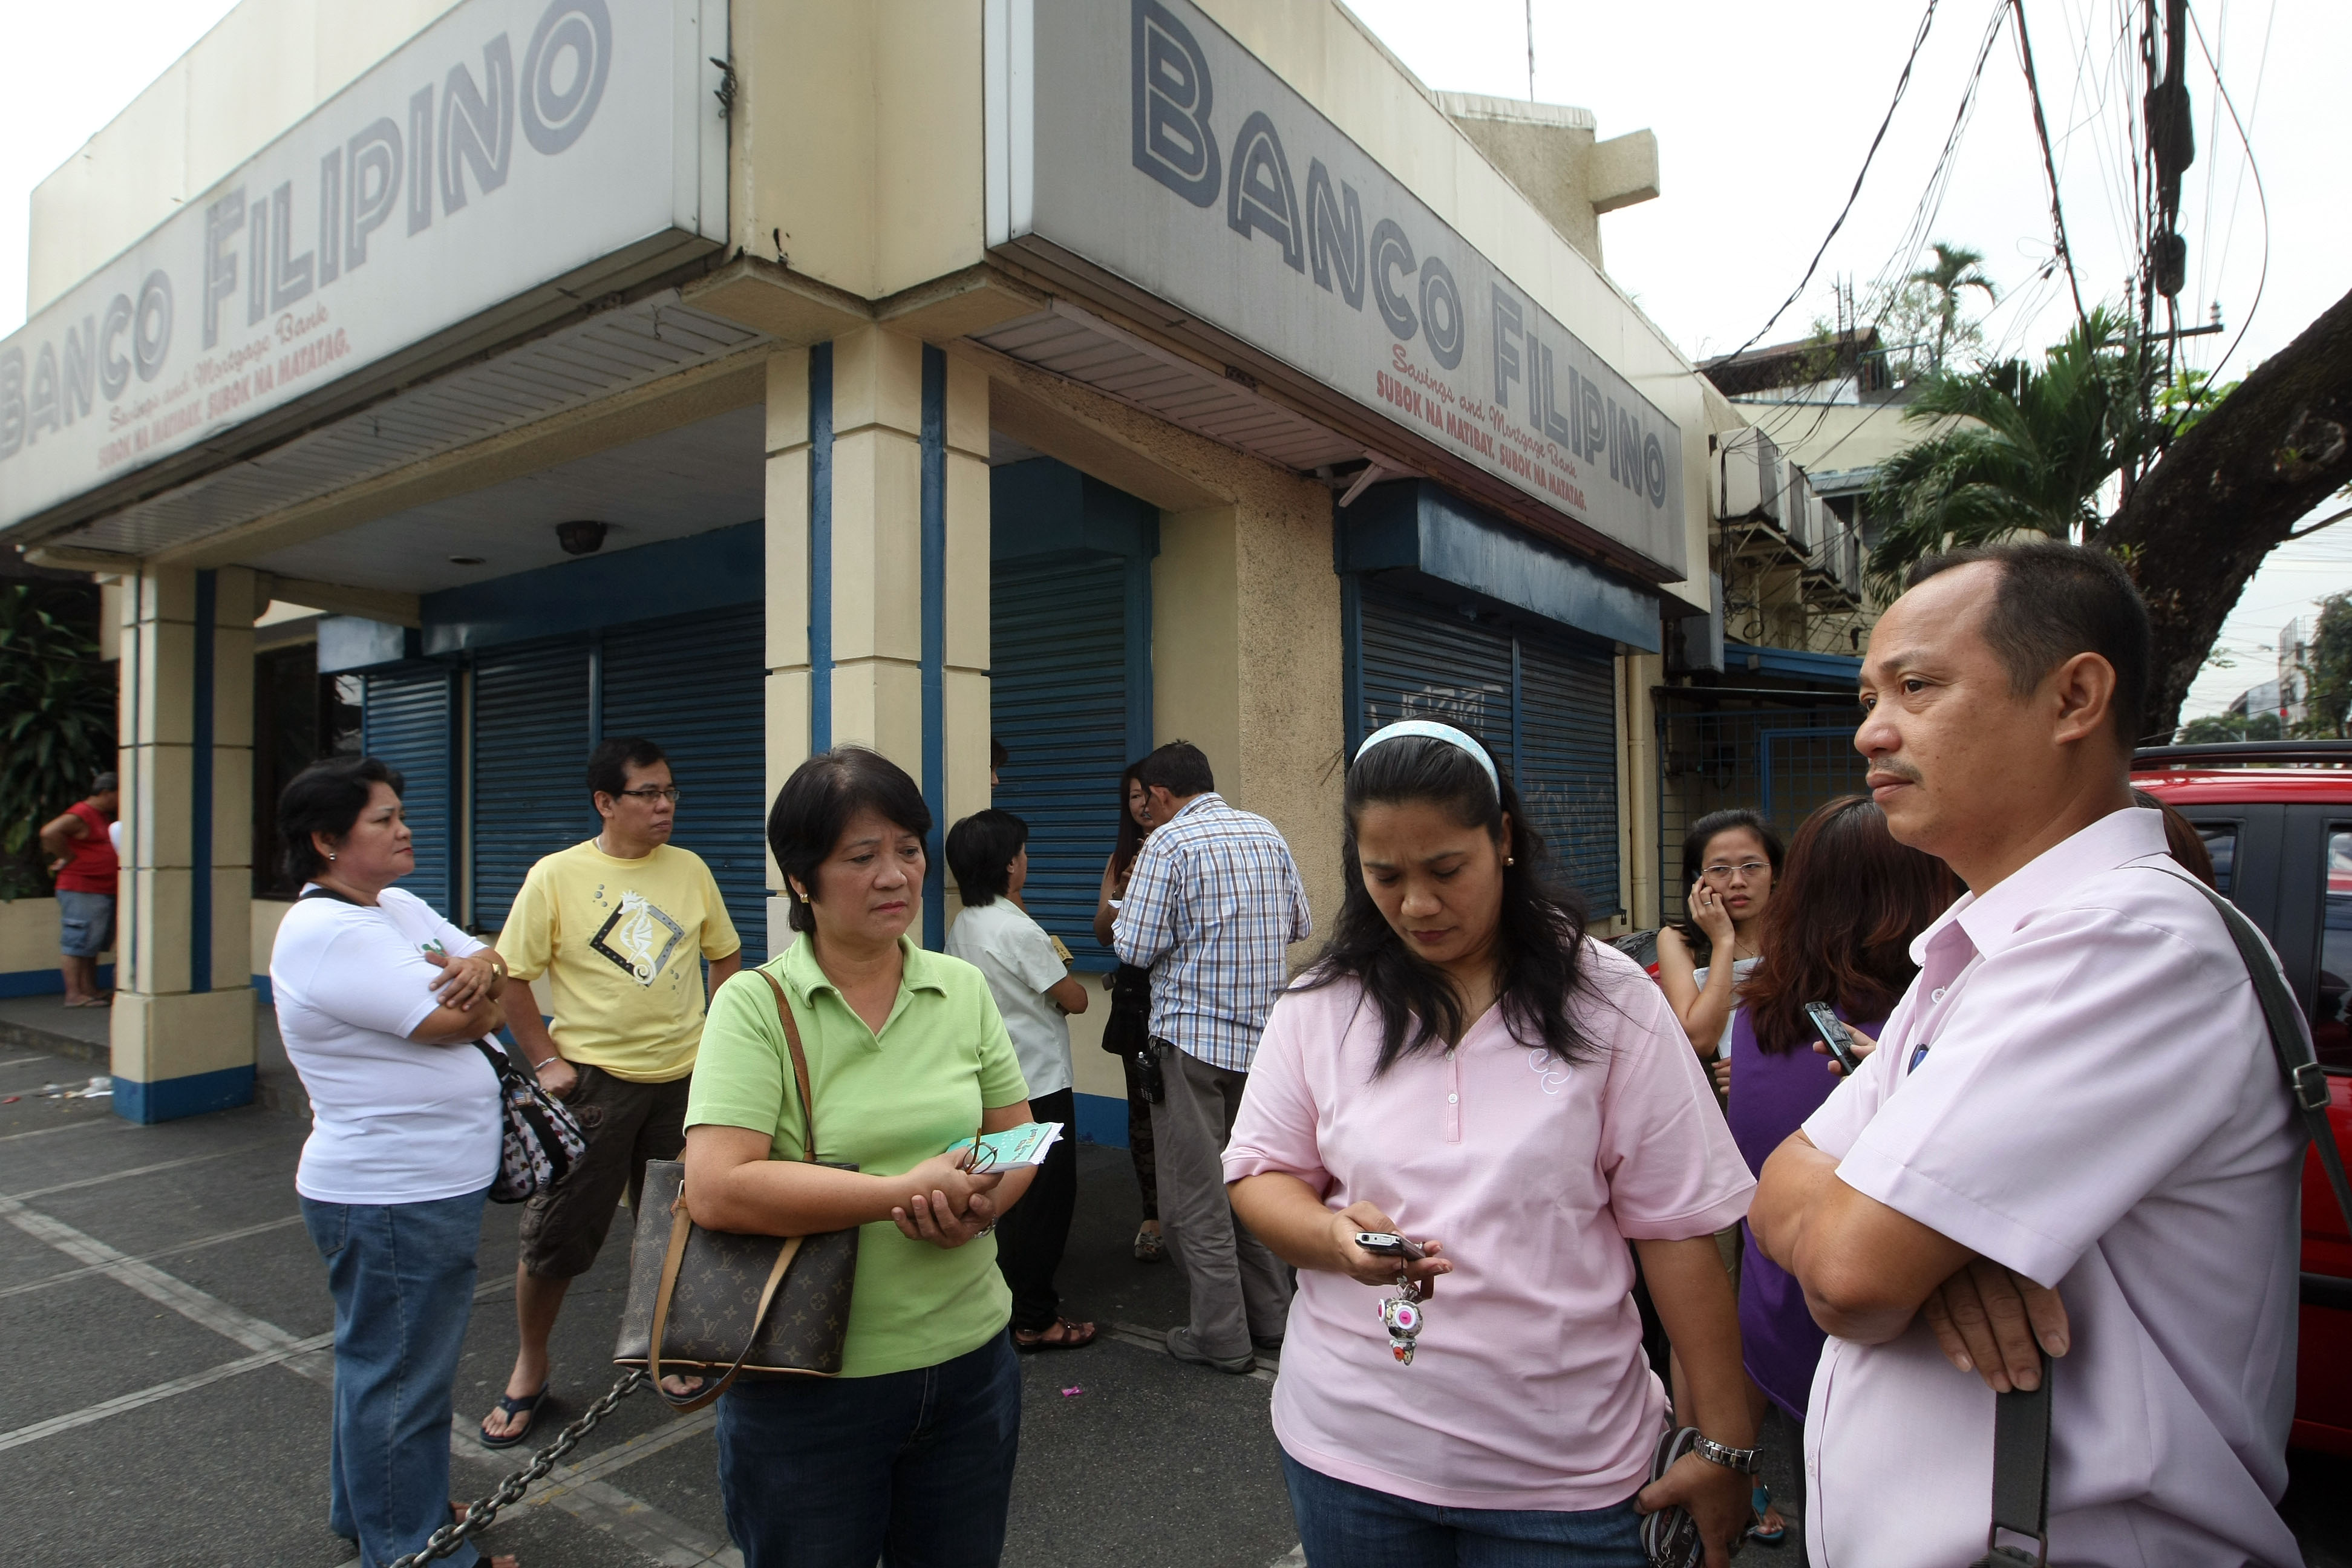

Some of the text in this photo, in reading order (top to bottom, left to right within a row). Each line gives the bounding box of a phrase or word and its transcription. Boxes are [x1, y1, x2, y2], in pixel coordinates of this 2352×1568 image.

[0, 0, 612, 462] BANCO FILIPINO
[1131, 0, 1667, 509] BANCO FILIPINO
[253, 364, 274, 396] NA
[275, 300, 330, 344] Bank
[1377, 370, 1422, 419] SUBOK
[1425, 396, 1444, 431] NA
[1500, 443, 1532, 482] SUBOK
[1534, 463, 1547, 489] NA
[1393, 344, 1577, 479] Savings and Mortgage Bank
